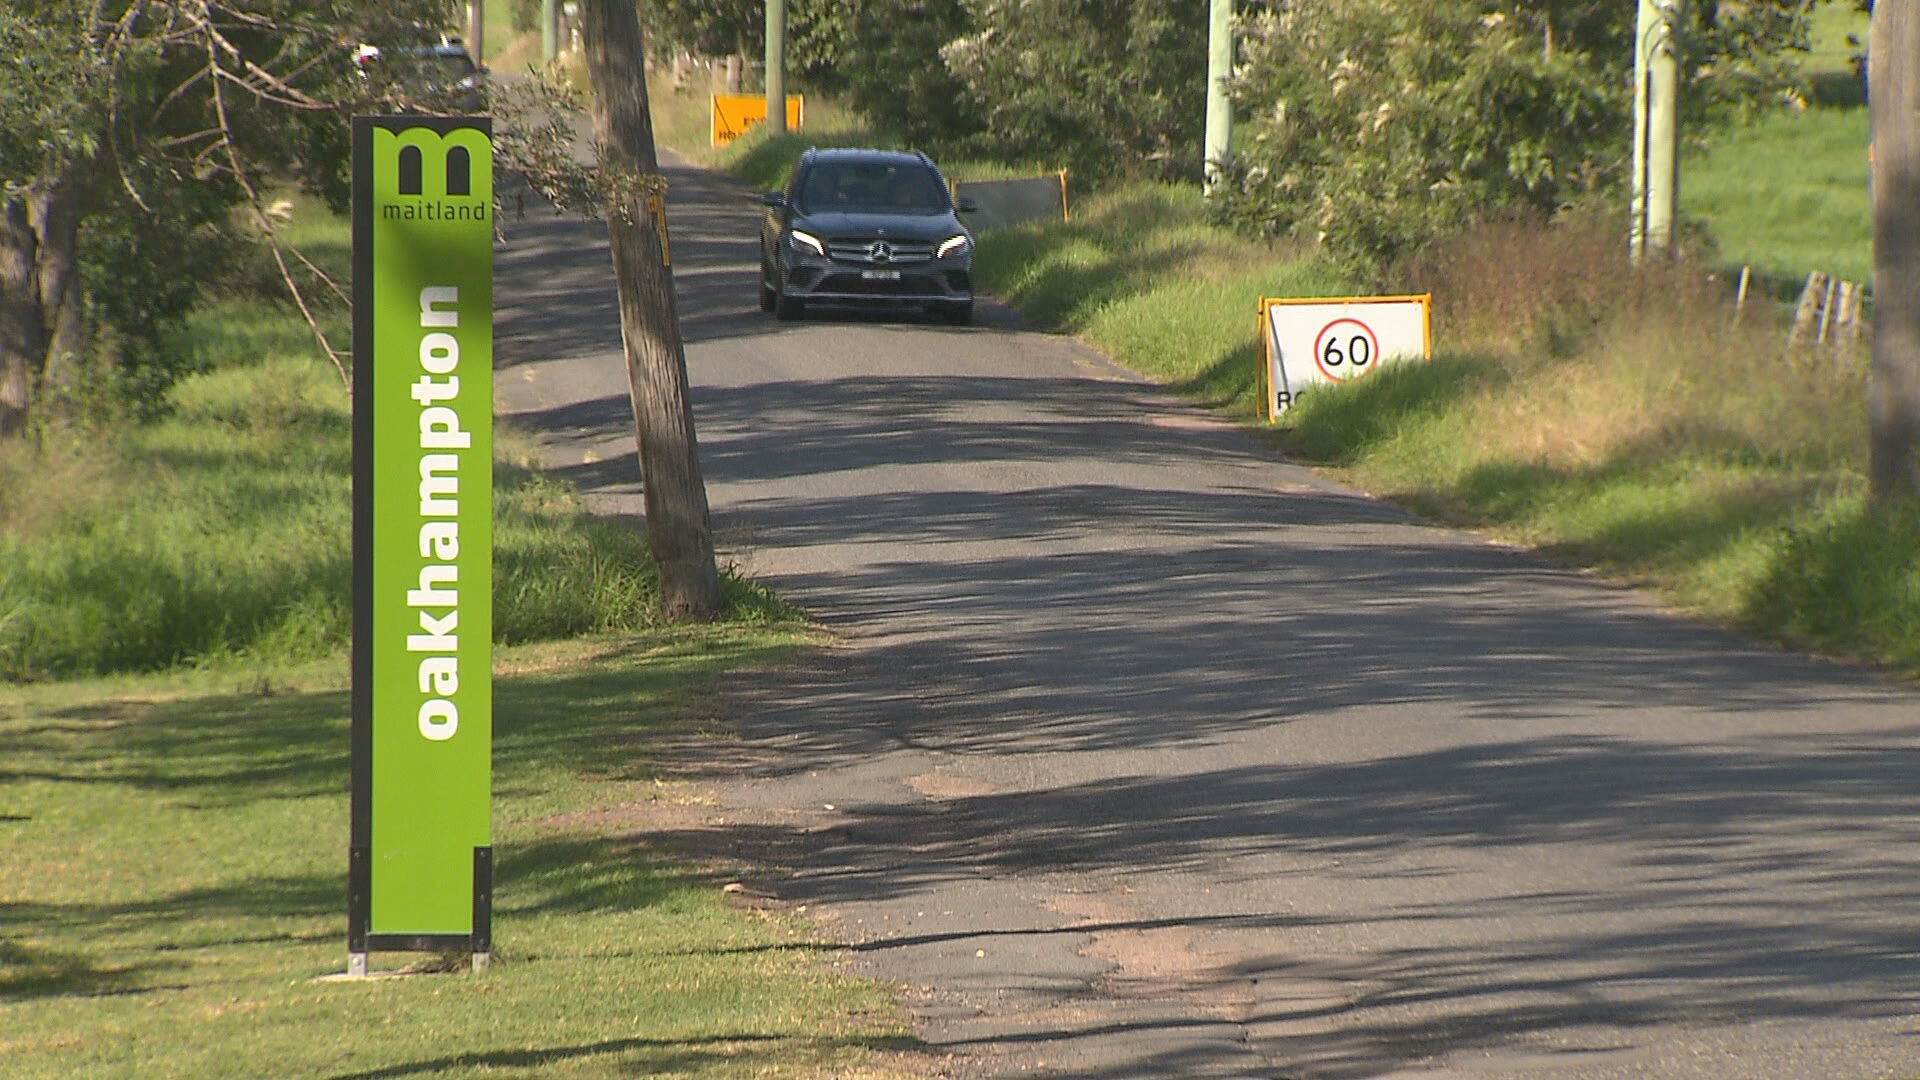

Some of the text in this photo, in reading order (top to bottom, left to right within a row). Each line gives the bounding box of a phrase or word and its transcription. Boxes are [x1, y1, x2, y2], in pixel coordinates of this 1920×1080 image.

[383, 201, 485, 220] maitland
[1324, 335, 1369, 366] 60
[406, 285, 471, 742] oakhampton
